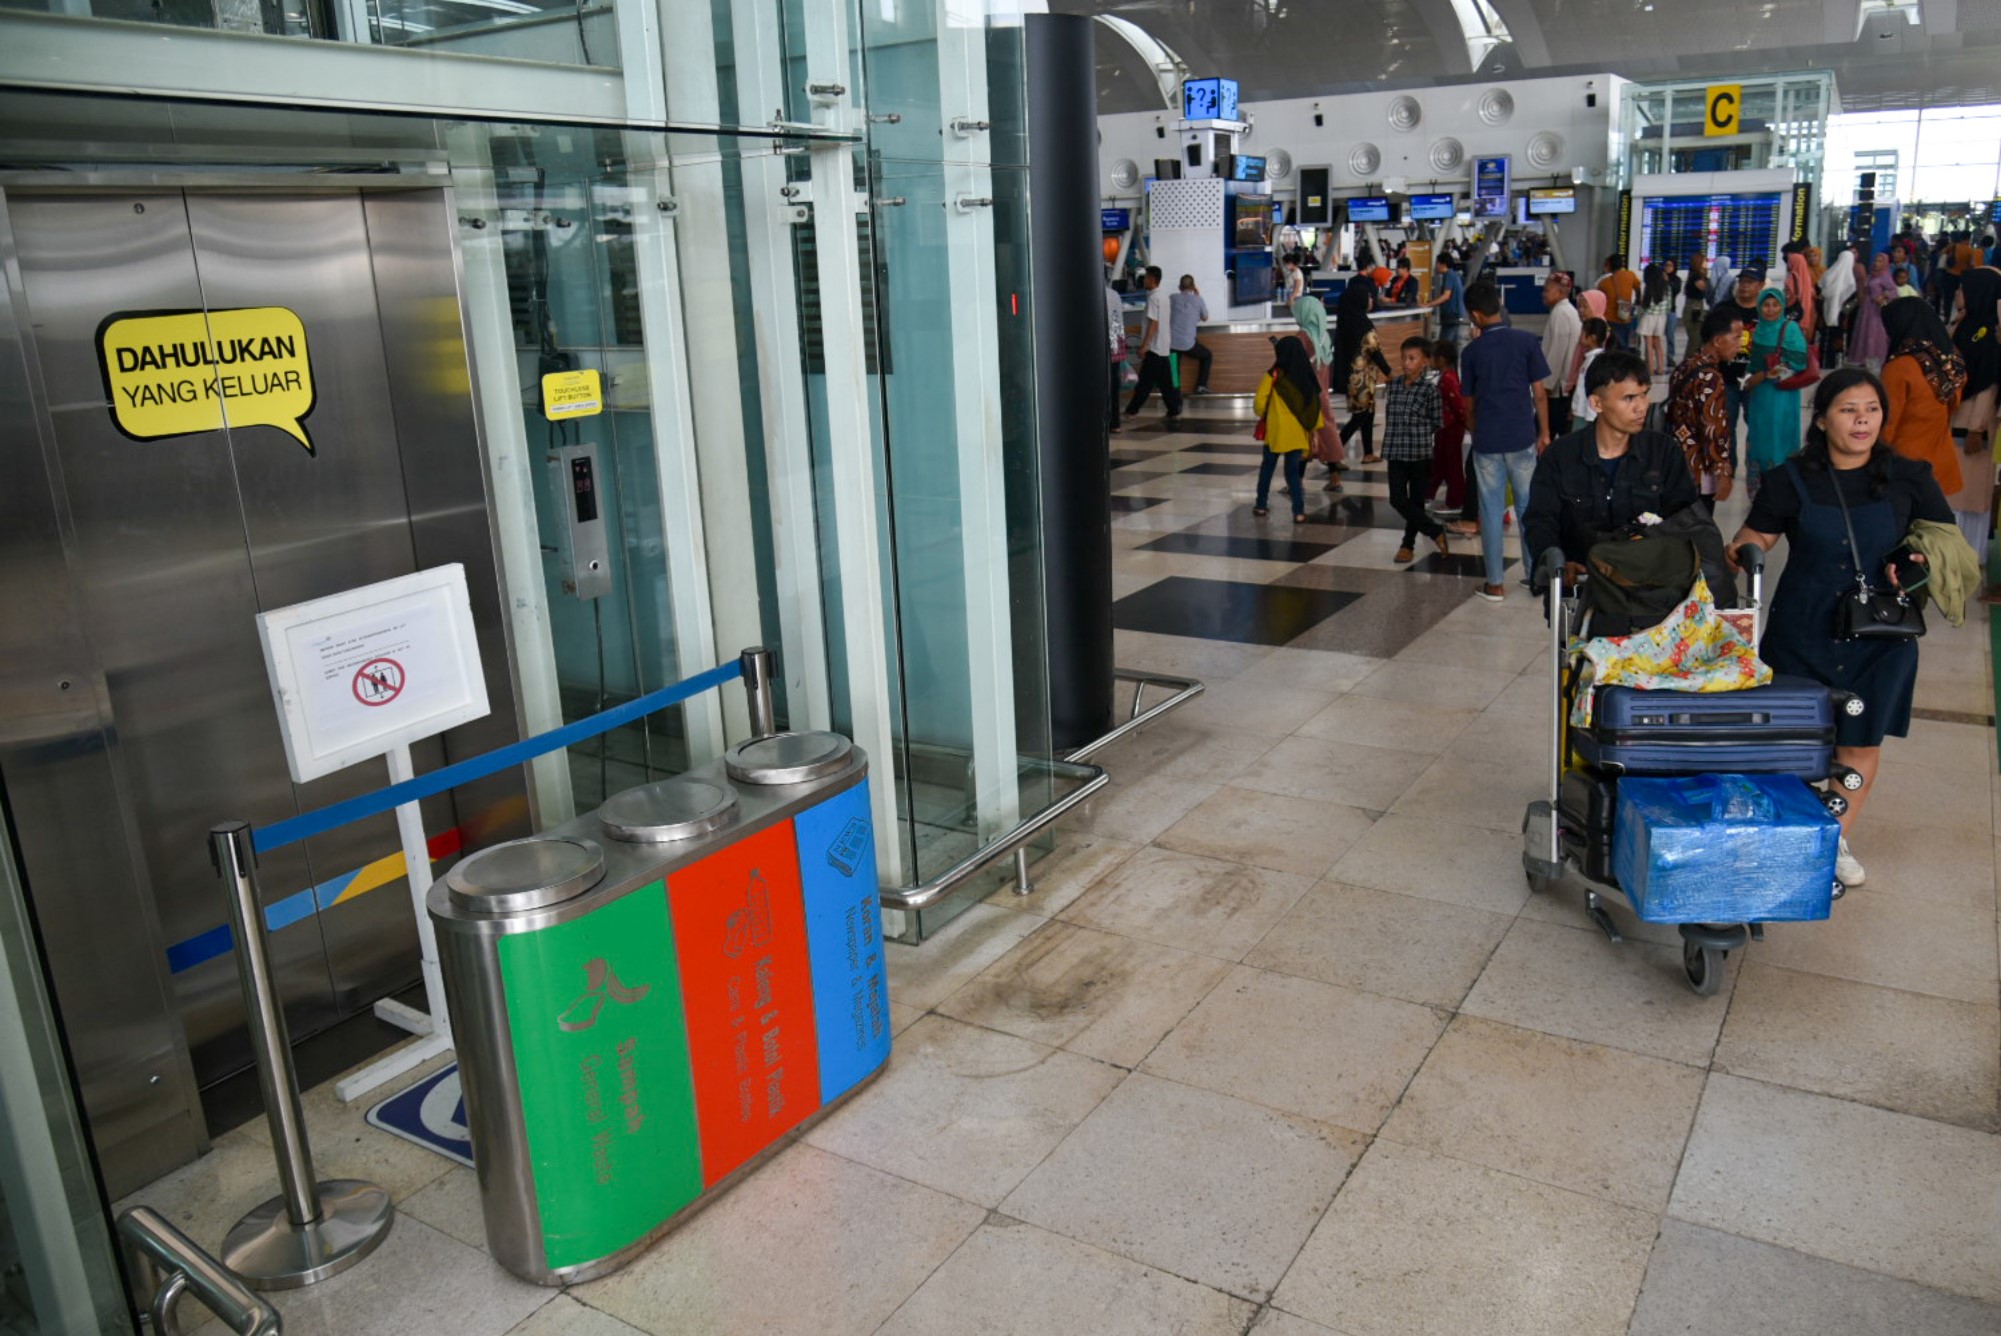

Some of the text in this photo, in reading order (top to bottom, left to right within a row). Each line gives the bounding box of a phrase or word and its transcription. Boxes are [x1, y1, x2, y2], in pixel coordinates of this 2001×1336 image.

[1711, 92, 1734, 128] C
[1792, 188, 1805, 242] formation
[116, 335, 296, 373] DAHULUKAN
[122, 370, 302, 408] YANG KELUAR
[844, 906, 860, 971] Newspaper
[860, 895, 873, 946] Koran
[866, 952, 878, 968] &
[760, 1010, 778, 1026] &
[616, 1037, 646, 1134] Sampah
[580, 1055, 614, 1185] General Waste
